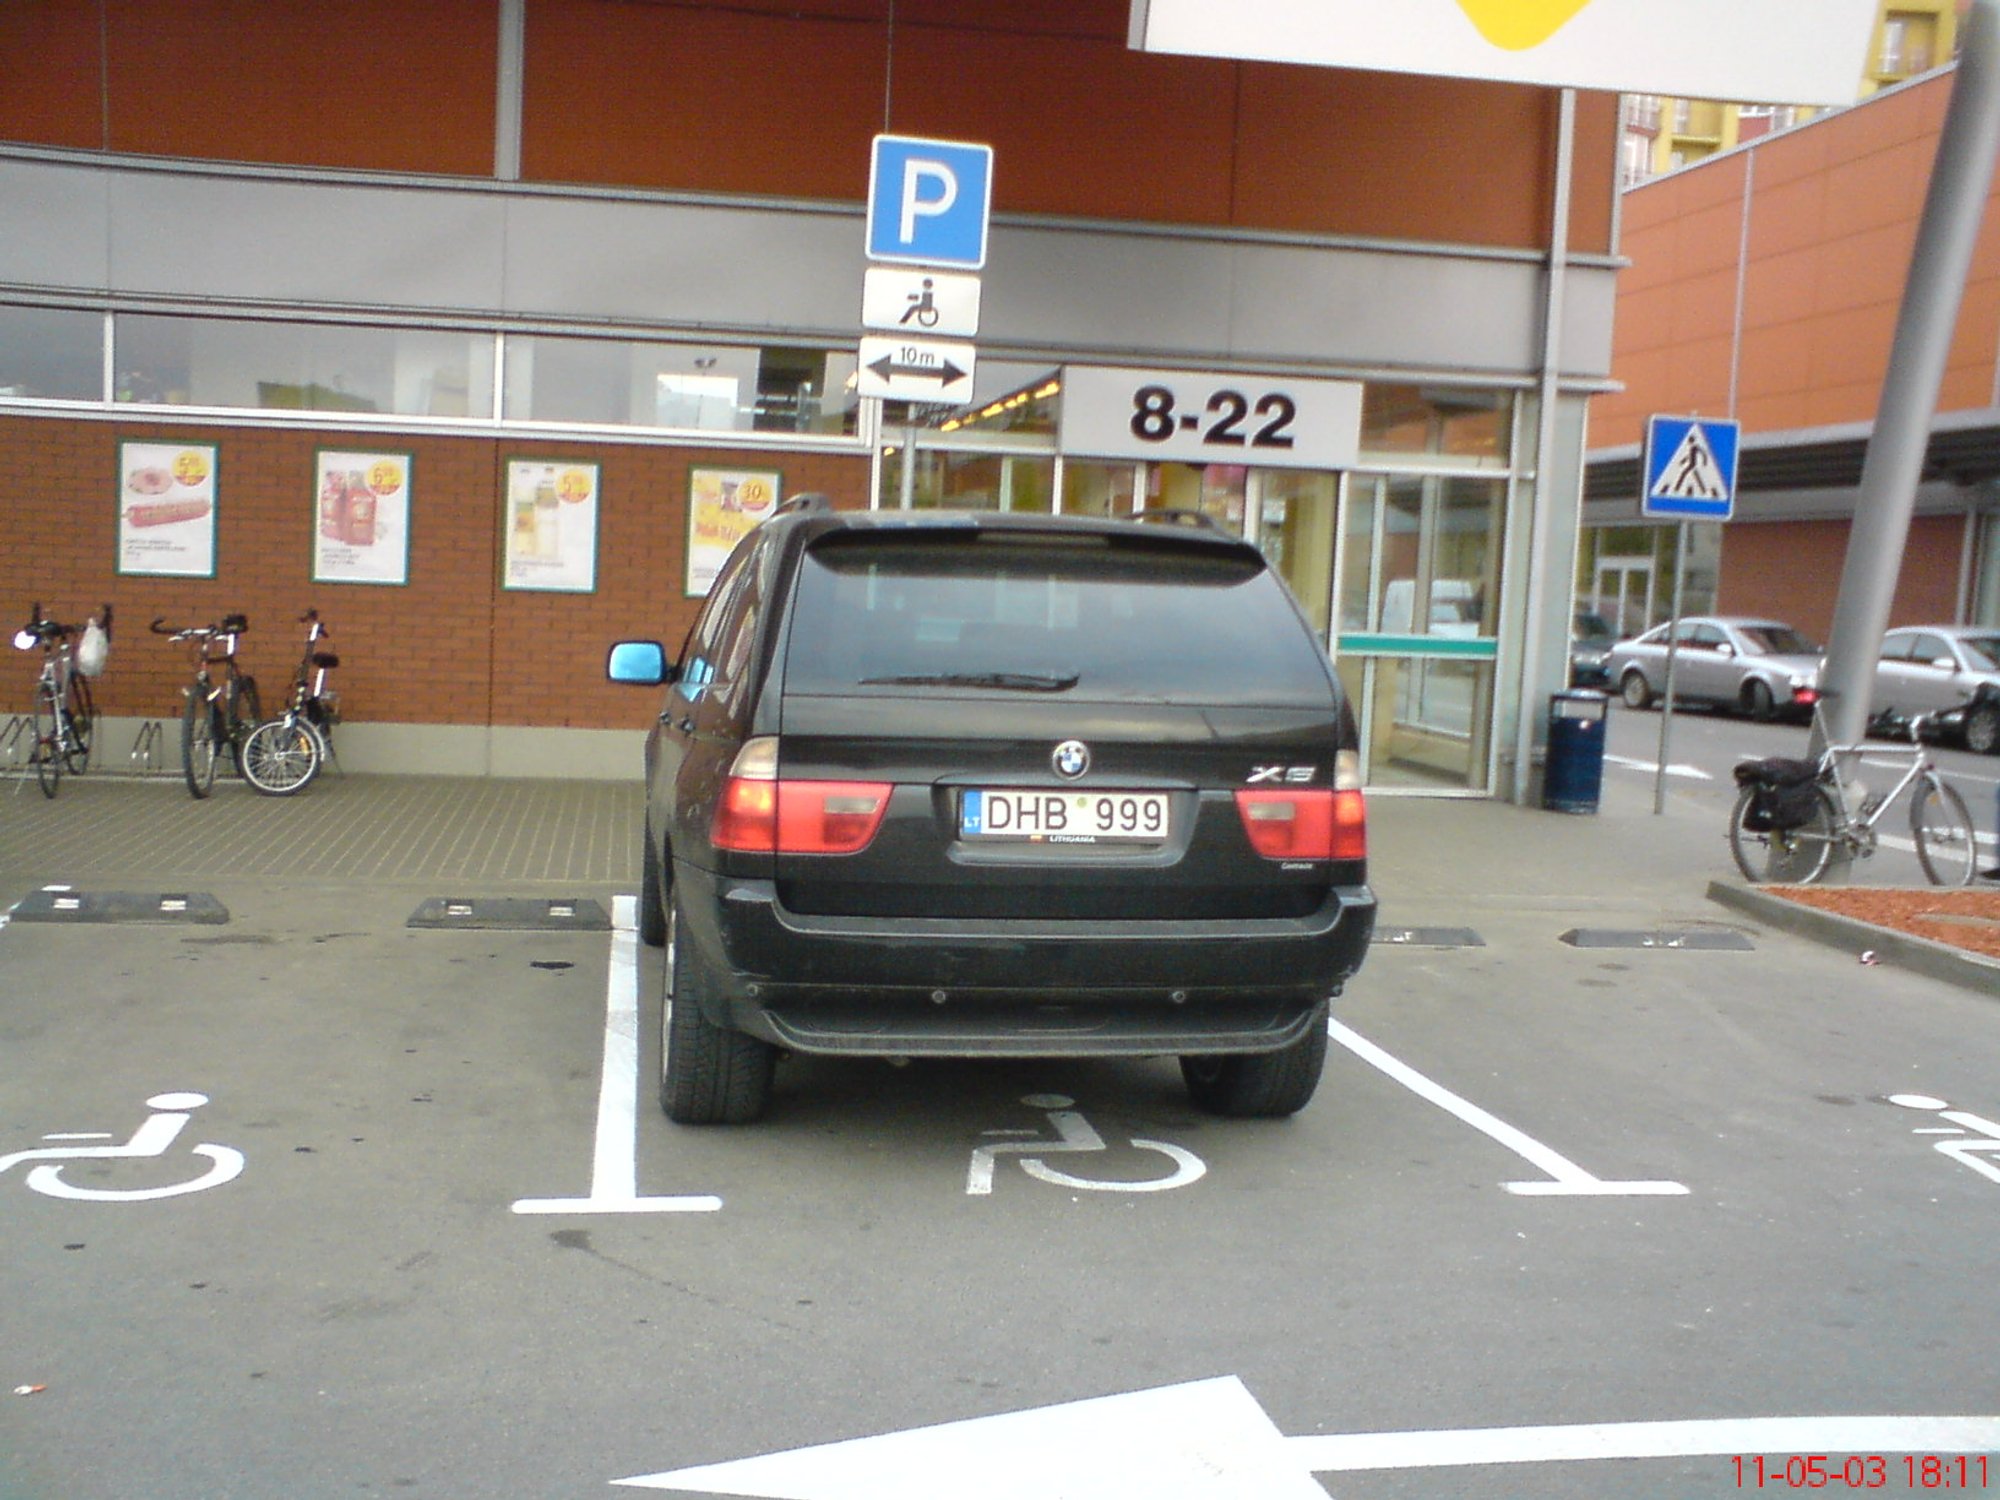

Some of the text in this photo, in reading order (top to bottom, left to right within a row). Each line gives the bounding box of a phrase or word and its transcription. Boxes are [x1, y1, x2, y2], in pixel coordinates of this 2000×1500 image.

[899, 158, 958, 244] P
[900, 346, 935, 367] 10 m
[1130, 385, 1297, 449] 8-22
[964, 816, 980, 828] LT
[987, 795, 1162, 832] DHB 999
